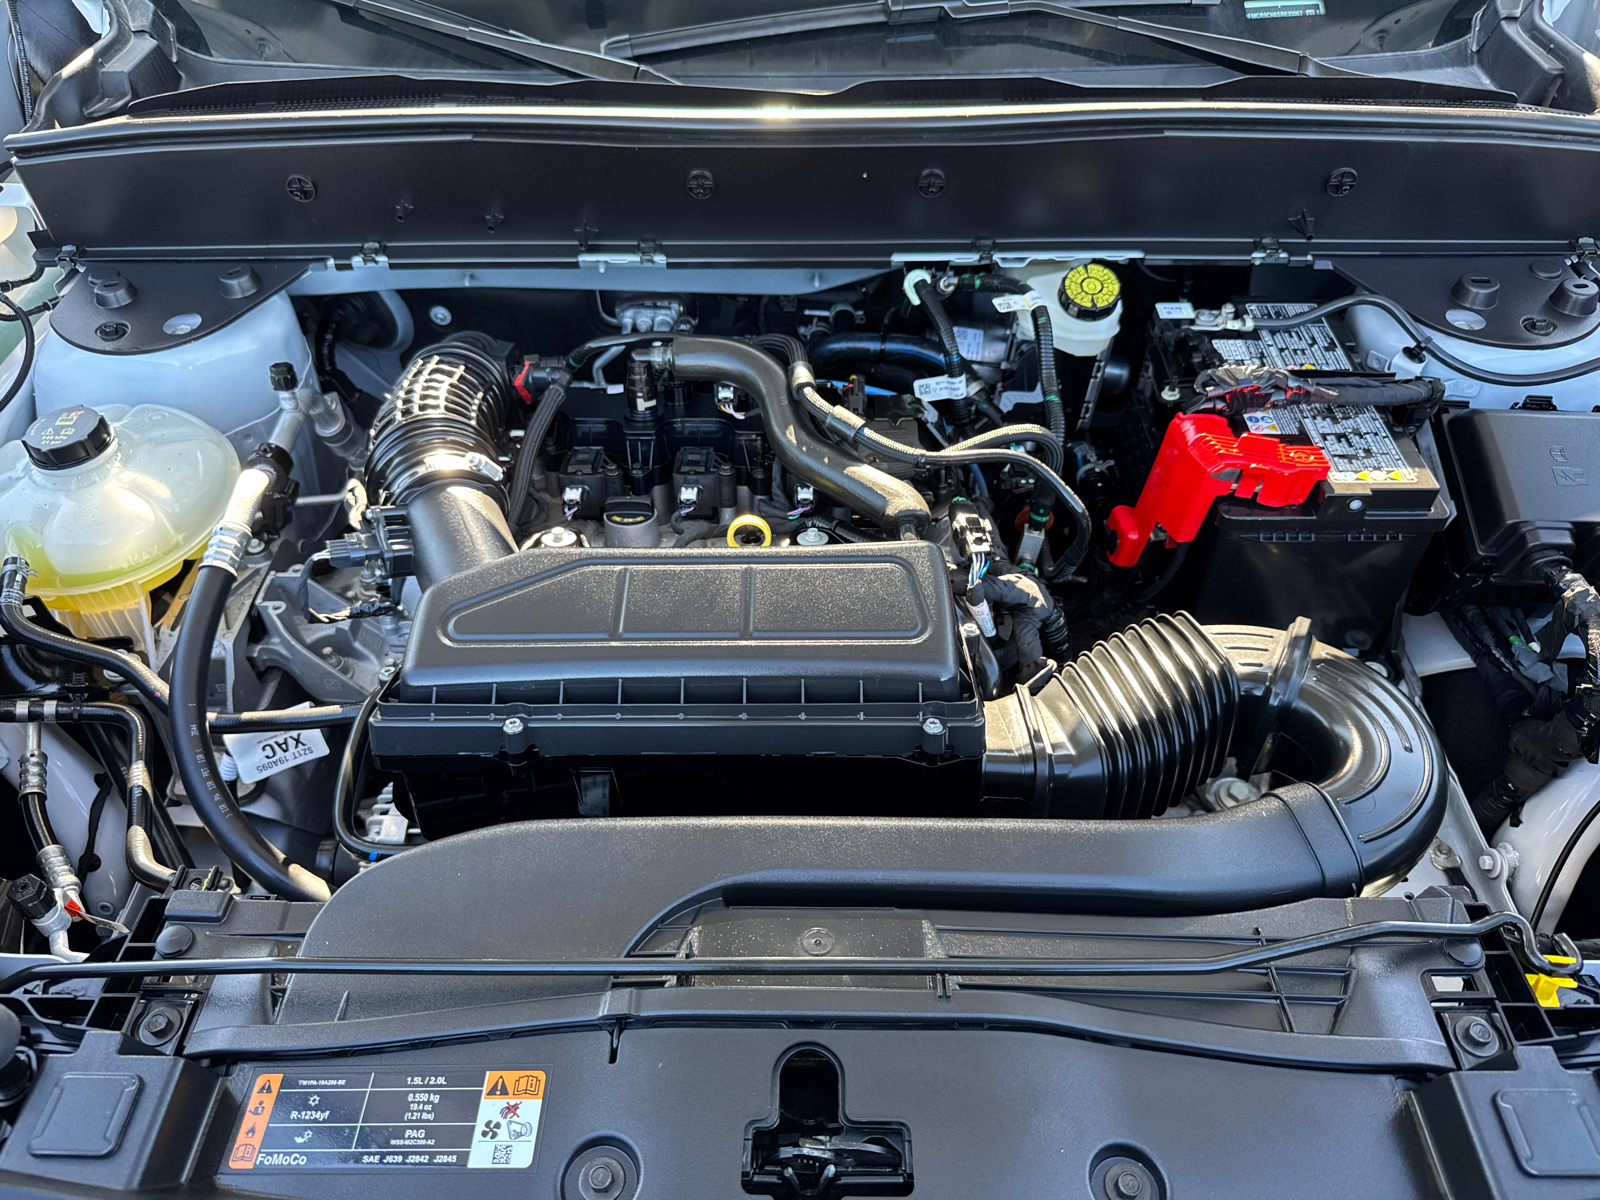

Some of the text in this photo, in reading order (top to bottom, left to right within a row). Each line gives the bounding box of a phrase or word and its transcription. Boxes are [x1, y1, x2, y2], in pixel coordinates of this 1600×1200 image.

[261, 732, 307, 760] XAC
[255, 746, 314, 774] SZ1T 19A095
[406, 1076, 423, 1085] 1.5L
[429, 1076, 447, 1085] 2.0L
[407, 1093, 440, 1104] 0.550 kg
[409, 1103, 423, 1111] 19.4
[290, 1110, 330, 1122] R-1234yf
[404, 1112, 435, 1121] (1.21 lbs)
[404, 1129, 426, 1139] PAG
[256, 1153, 307, 1166] FoMoCo
[362, 1155, 457, 1163] SAE J639 J2842 J2845
